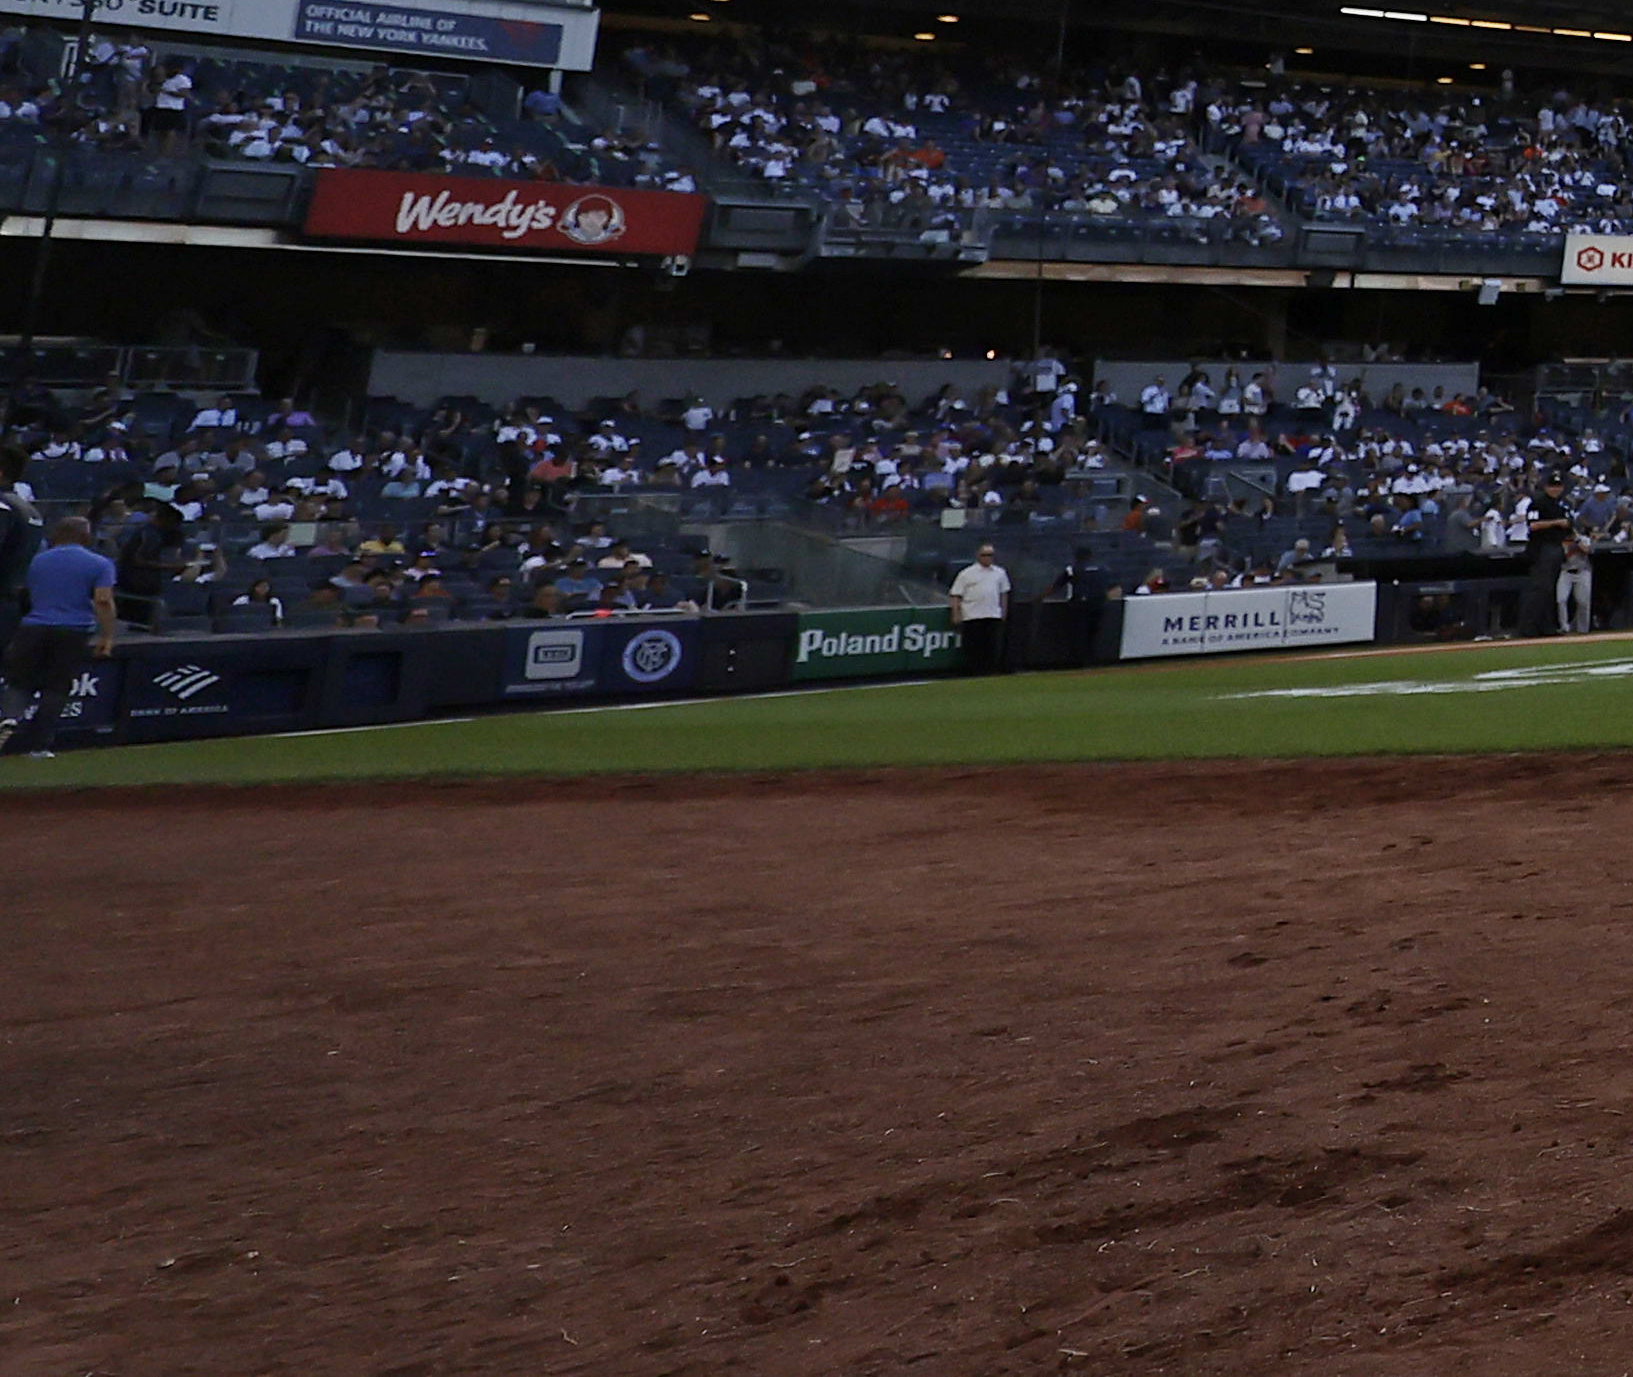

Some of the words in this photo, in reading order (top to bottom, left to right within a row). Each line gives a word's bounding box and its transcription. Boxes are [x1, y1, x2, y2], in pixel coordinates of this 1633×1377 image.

[304, 4, 371, 24] OFFICIAL
[376, 12, 432, 31] AIRLINE
[436, 19, 457, 32] OF
[304, 19, 335, 35] THE
[337, 24, 373, 40] NEW
[376, 28, 417, 45] YORK
[395, 189, 556, 239] Wendy's
[1163, 610, 1281, 633] MERRILL
[796, 624, 899, 663] Poland
[1227, 631, 1281, 643] AMERICA
